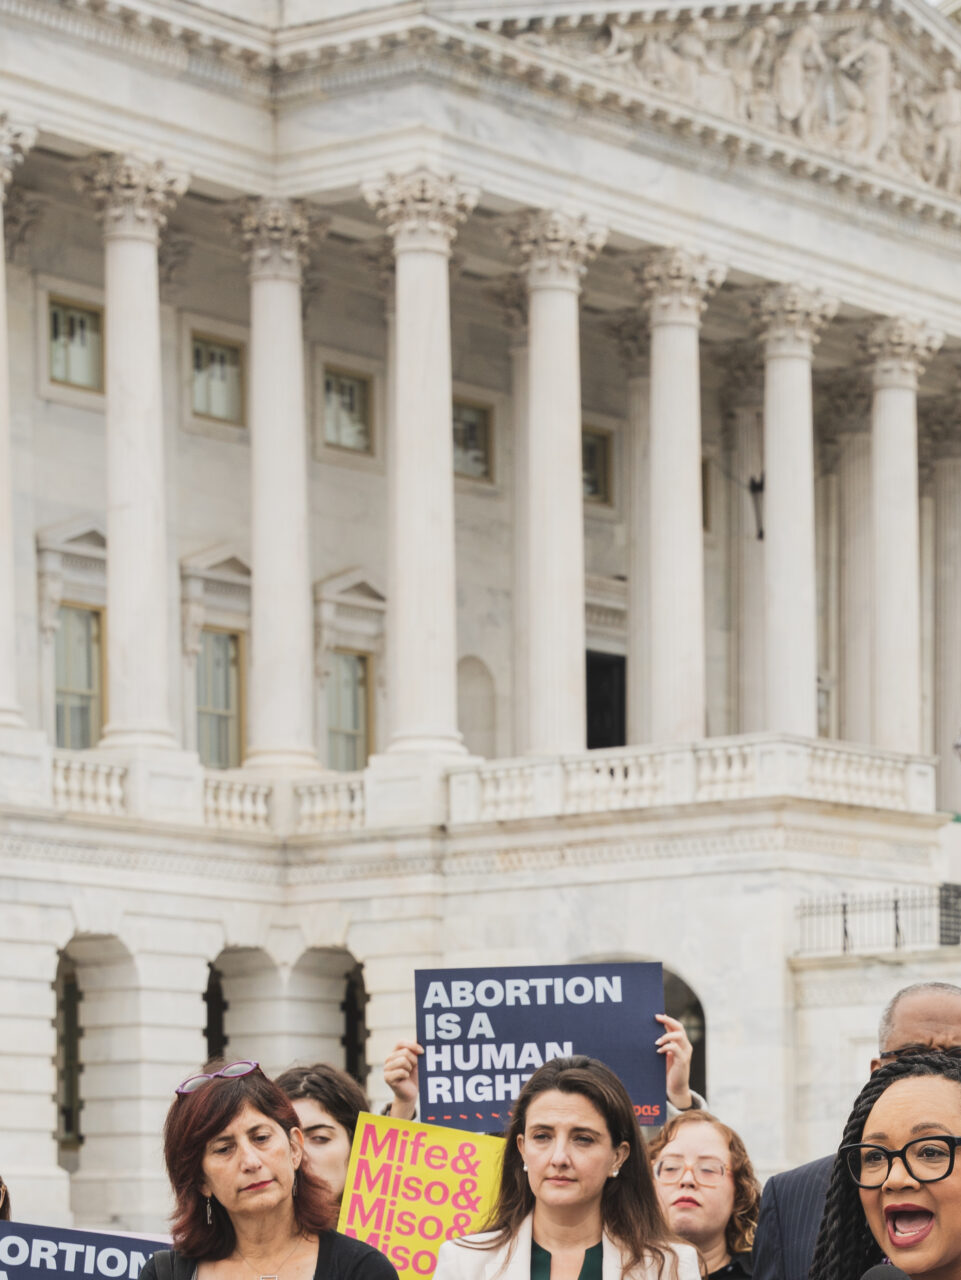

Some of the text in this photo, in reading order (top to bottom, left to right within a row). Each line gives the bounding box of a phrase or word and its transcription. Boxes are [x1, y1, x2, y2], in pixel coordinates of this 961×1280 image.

[423, 976, 622, 1008] ABORTION
[425, 1012, 496, 1040] IS A
[427, 1073, 534, 1104] RIGH
[359, 1123, 482, 1177] Mife&
[353, 1158, 482, 1213] Miso&
